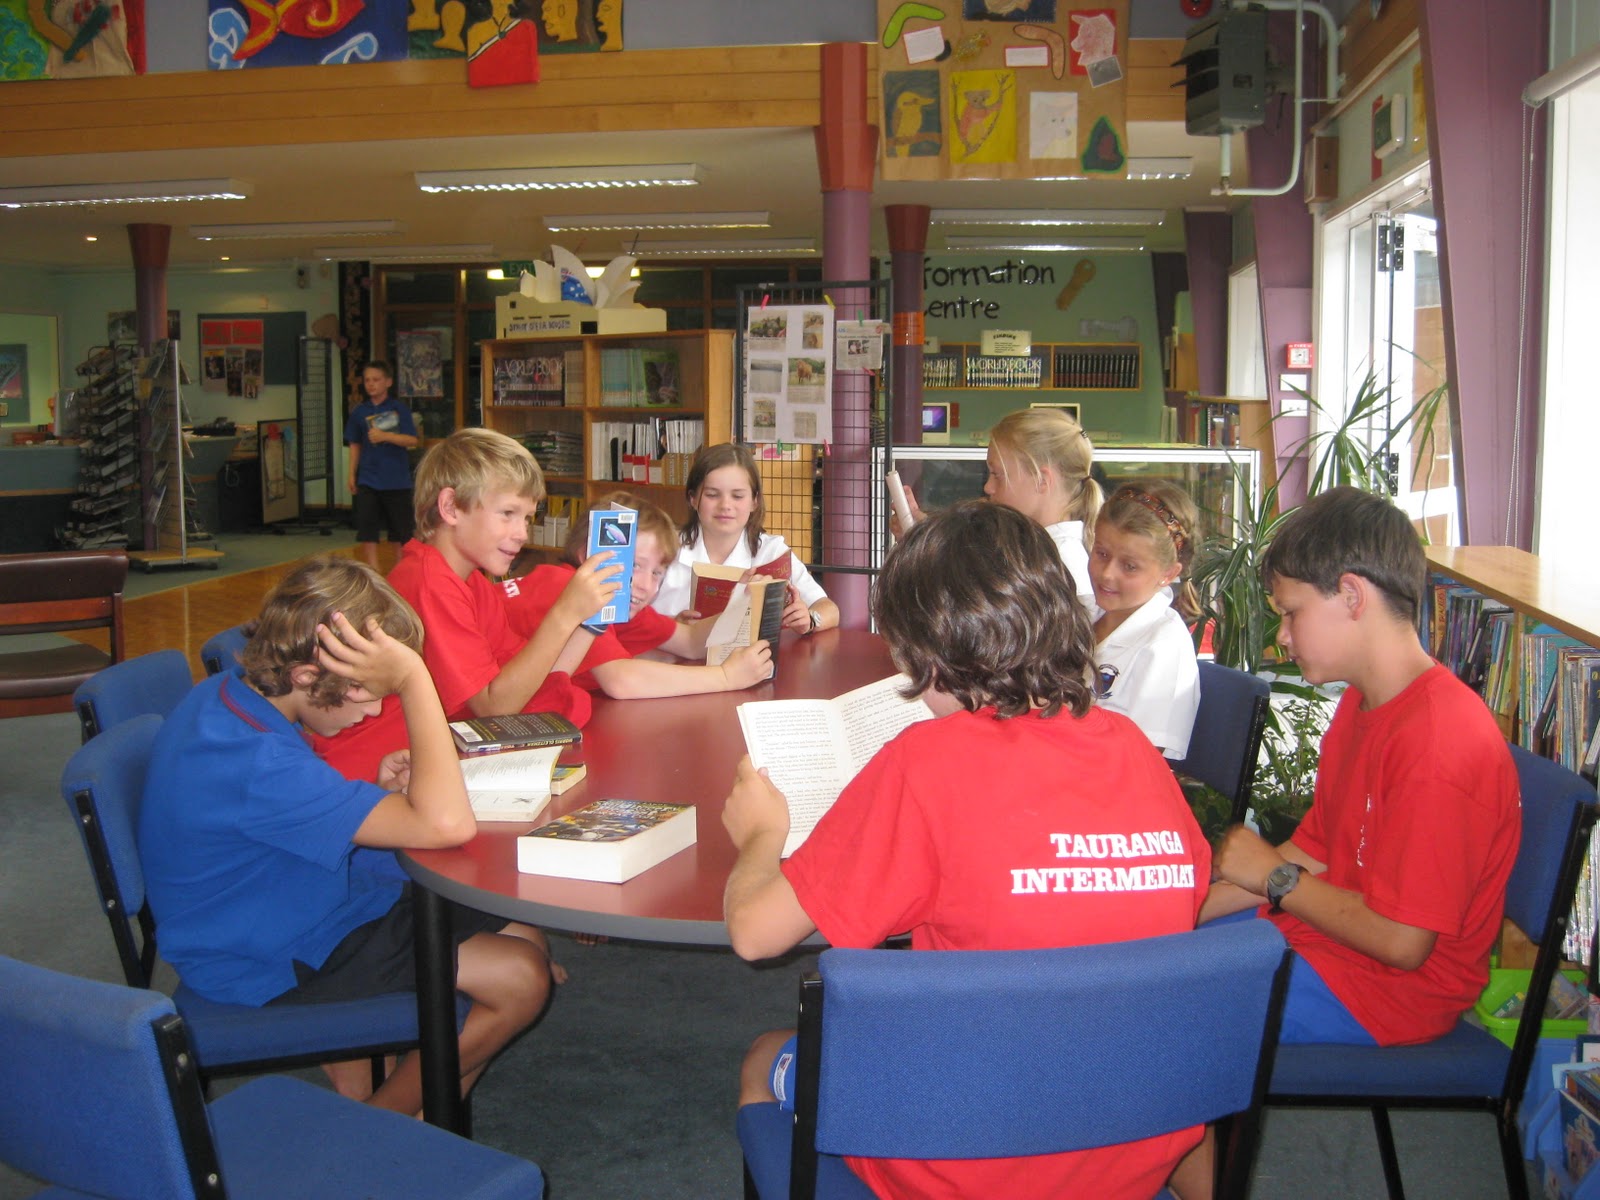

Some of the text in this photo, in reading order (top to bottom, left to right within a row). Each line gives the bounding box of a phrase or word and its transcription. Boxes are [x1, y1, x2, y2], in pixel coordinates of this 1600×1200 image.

[924, 257, 1055, 290] formation
[924, 296, 1000, 319] entre
[1050, 830, 1184, 858] TAURANGA
